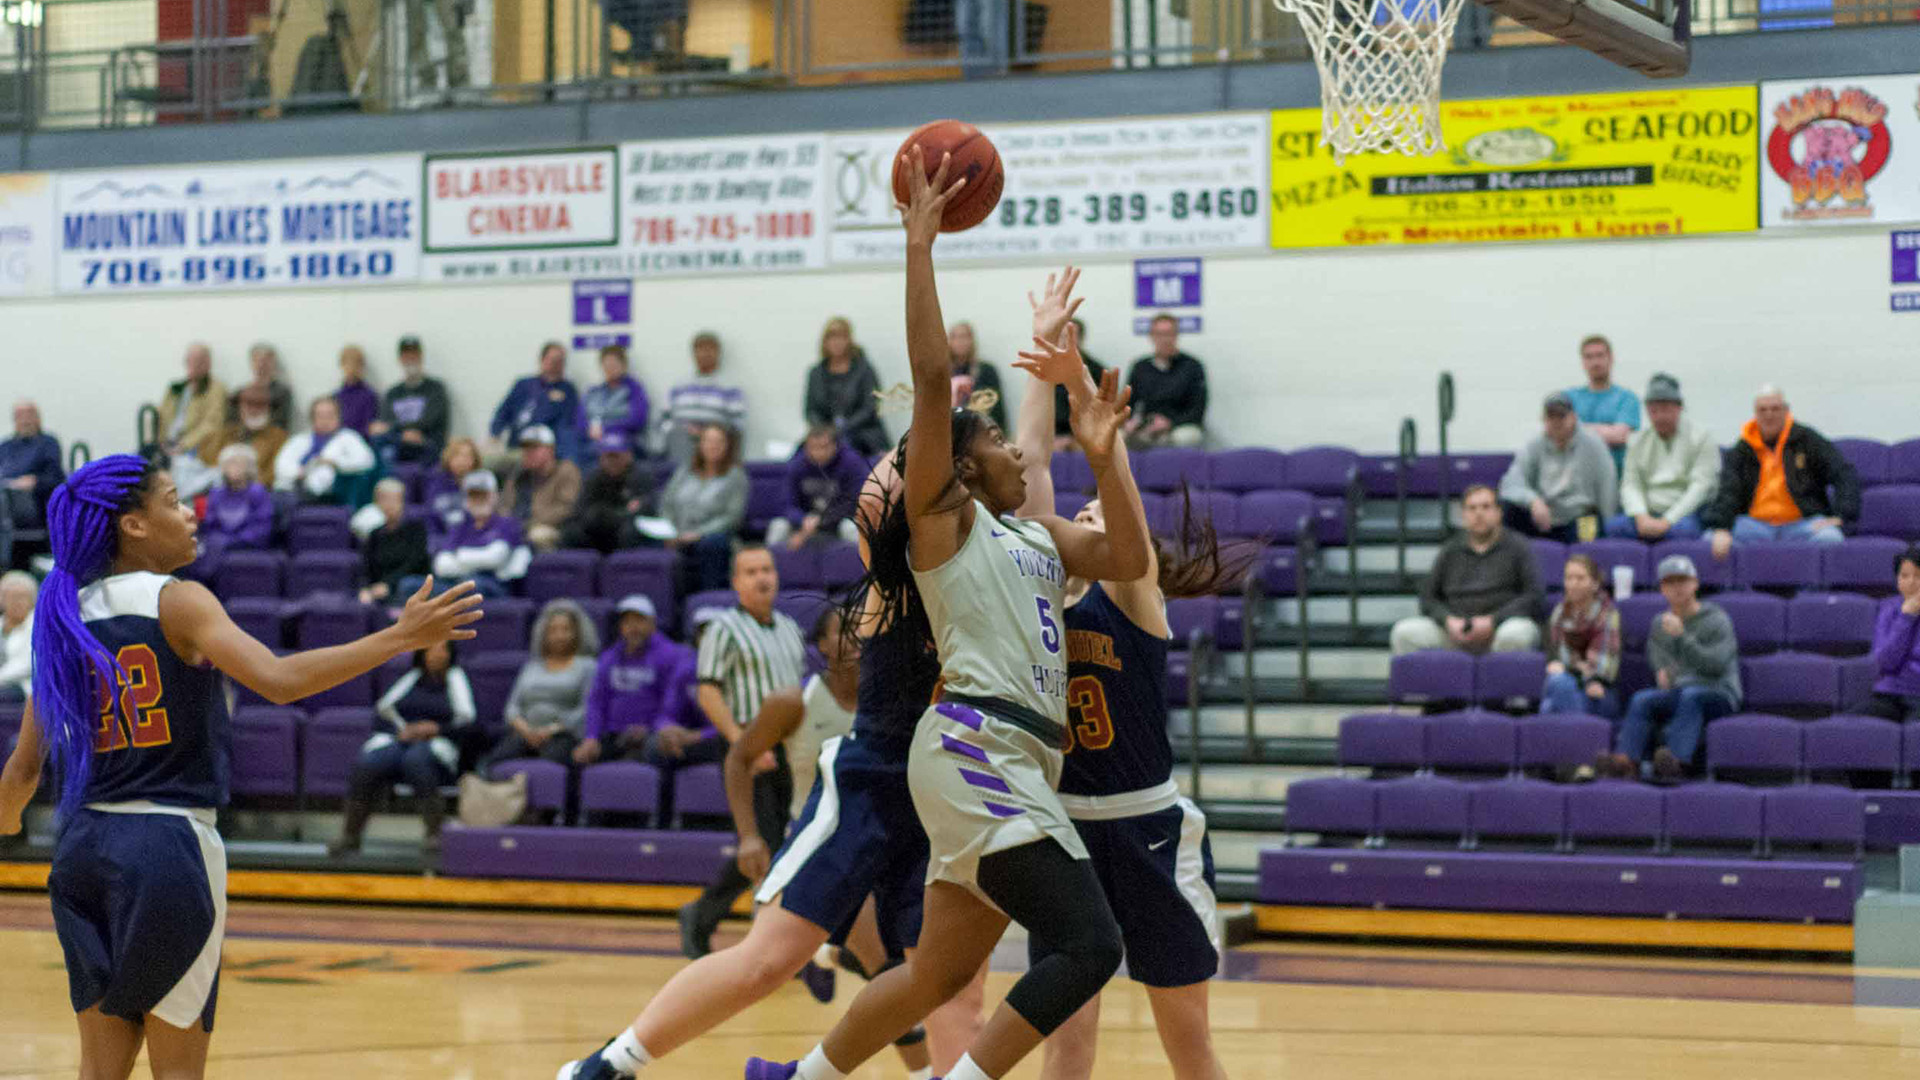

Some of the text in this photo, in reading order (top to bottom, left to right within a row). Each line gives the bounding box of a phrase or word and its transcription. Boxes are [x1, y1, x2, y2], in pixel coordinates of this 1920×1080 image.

[1583, 108, 1754, 144] SEAFOOD
[436, 163, 605, 197] BLAIRSVILLE
[1271, 171, 1361, 212] PIZZA
[1385, 166, 1637, 194] Italian Restaurant
[1660, 161, 1742, 194] BIRDS
[63, 211, 187, 250] MOUNTAIN
[199, 205, 270, 246] LAKES
[281, 199, 413, 243] MORTGAGE
[467, 203, 572, 235] CINEMA
[1000, 187, 1259, 227] 828-389-8460
[1402, 222, 1562, 243] Mountain
[1573, 216, 1685, 236] Lions!
[82, 250, 394, 288] 706-896-1860
[594, 296, 613, 322] L
[1034, 594, 1061, 655] 5
